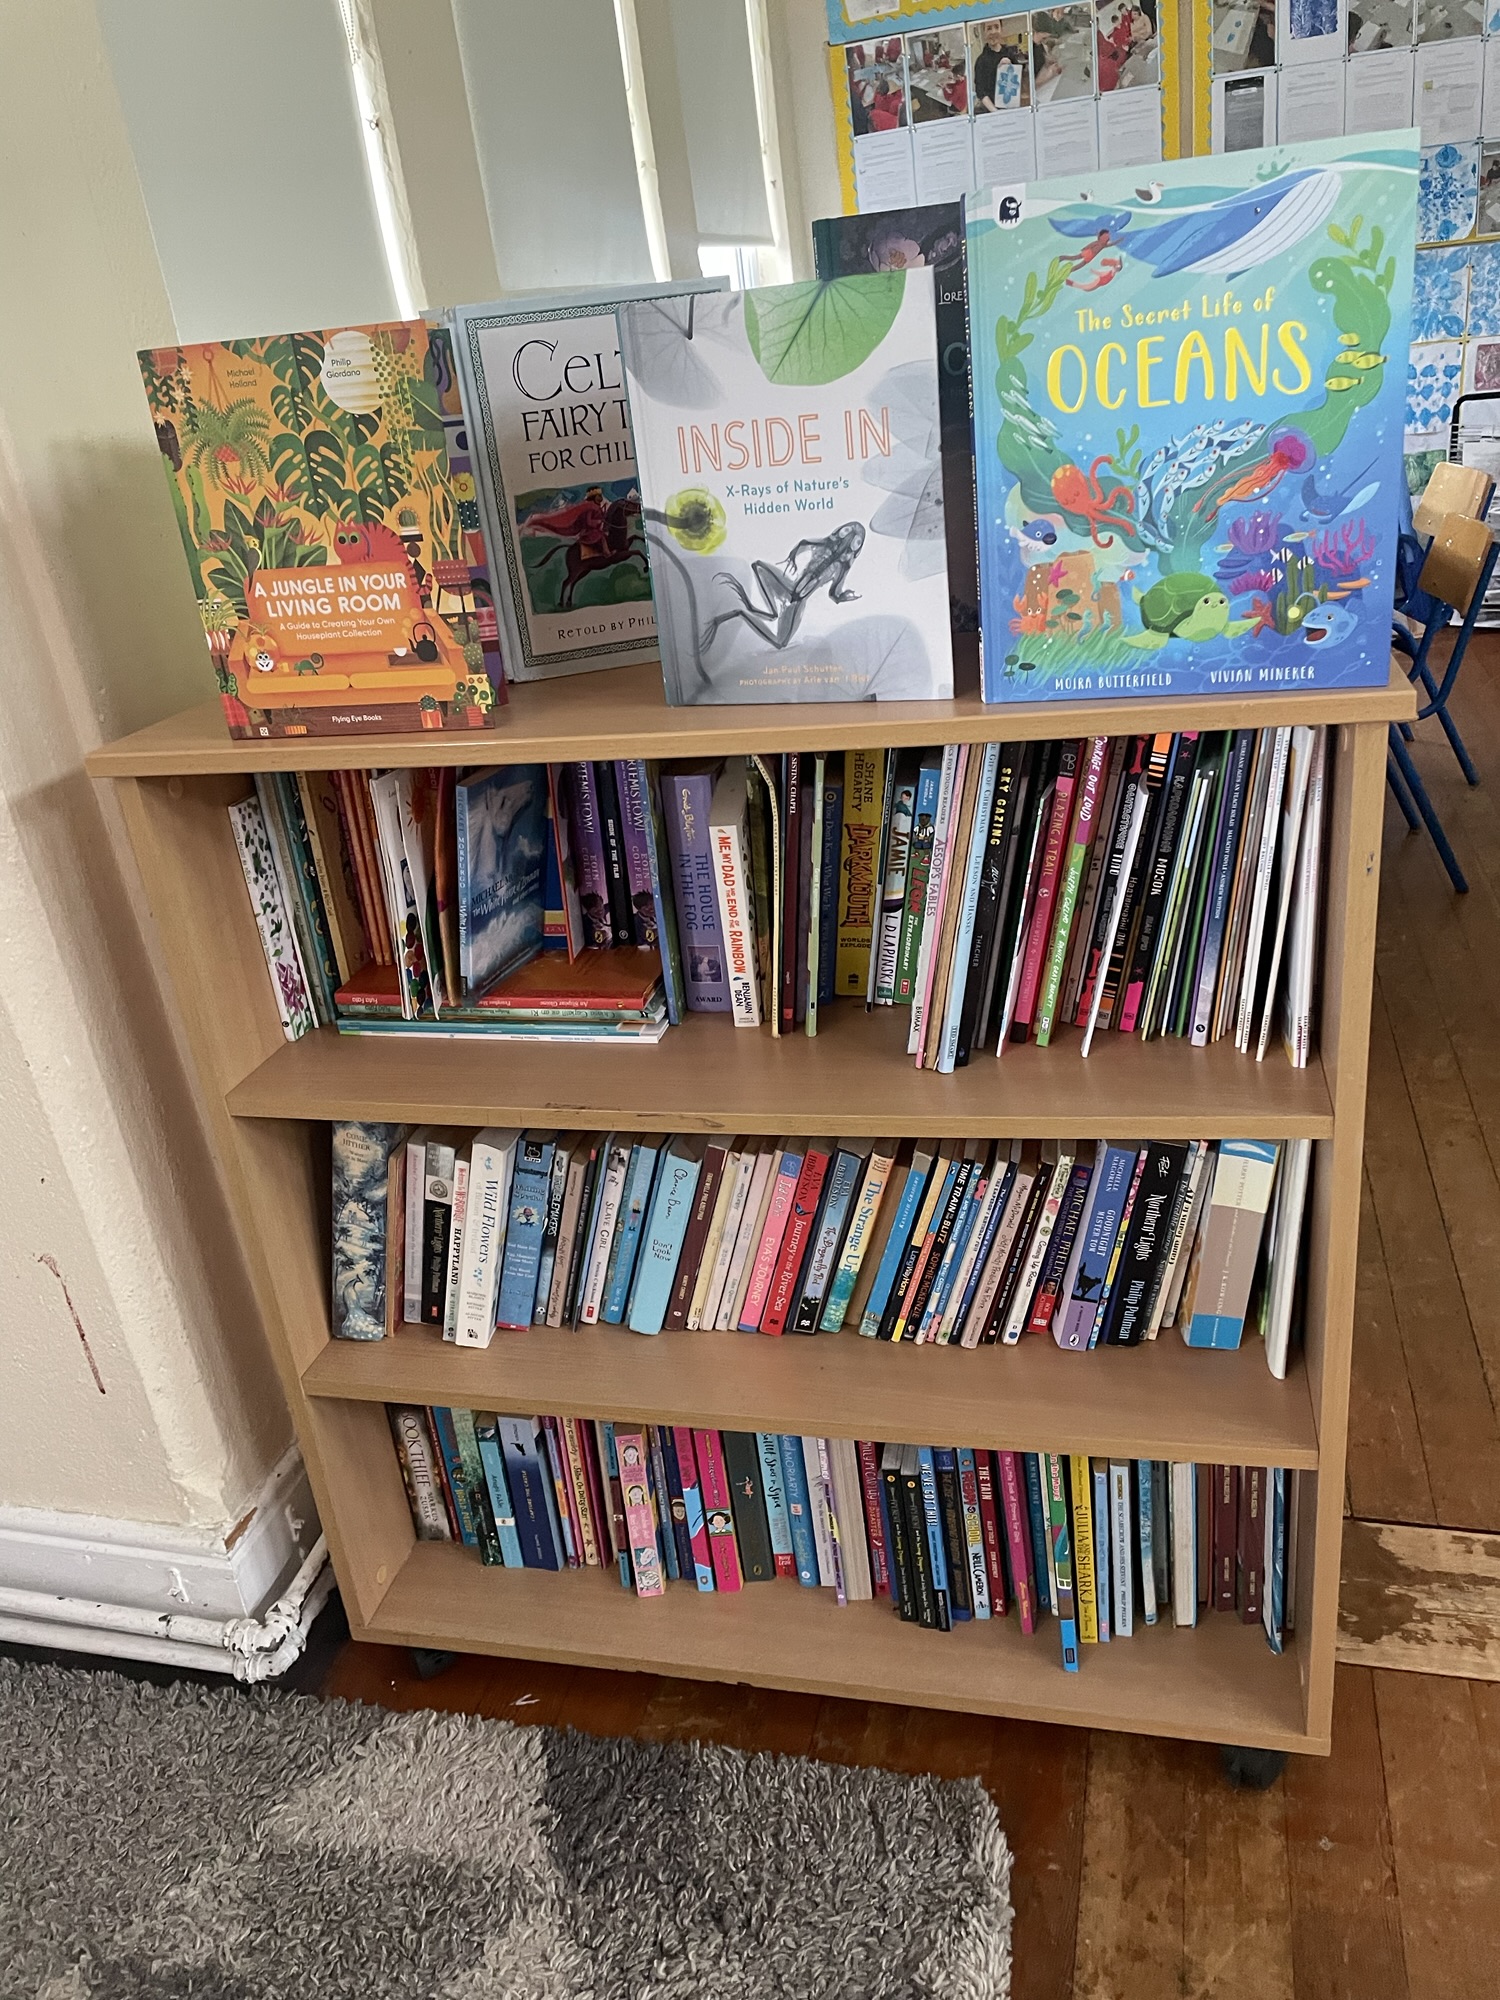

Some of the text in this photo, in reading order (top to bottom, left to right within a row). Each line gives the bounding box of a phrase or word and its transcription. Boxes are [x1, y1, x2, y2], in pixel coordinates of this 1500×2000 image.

[1074, 286, 1277, 333] The Secret Life of
[227, 368, 255, 378] Michael
[326, 368, 361, 379] Giordano
[331, 358, 351, 368] Philip
[1046, 321, 1312, 414] OCEANS
[229, 378, 257, 388] Holland
[520, 401, 603, 442] FAIRY
[529, 442, 634, 473] FOR CHIL
[677, 414, 822, 474] INSIDE
[844, 407, 892, 460] IN
[726, 477, 849, 498] X-Rays of Nature's
[743, 497, 834, 515] Hidden World
[254, 572, 407, 597] A JUNGLE IN YOUR
[266, 593, 401, 617] LIVING ROOM
[287, 622, 310, 630] Guide
[322, 619, 356, 629] Creating
[357, 618, 375, 626] Your
[297, 629, 382, 641] Houseplant Collection
[609, 621, 624, 631] BY
[628, 617, 657, 628] PHIL
[763, 665, 843, 674] Jan Schutten
[1055, 666, 1316, 691] MOIRA BUTTERFIELD VIVIAN MINEKER
[852, 752, 864, 811] HEGARTY
[864, 762, 875, 803] SHANE
[943, 772, 951, 794] YOUNG
[978, 754, 996, 833] GIFT CHRISTMAS
[1079, 775, 1098, 821] OUT LOUD
[631, 801, 645, 835] FOWL
[789, 787, 797, 815] CHAPEL
[939, 796, 948, 824] READERS
[990, 767, 1012, 846] SKY GAZING
[580, 802, 594, 835] FOWL
[581, 847, 592, 888] COLFER
[591, 855, 599, 880] EOIN
[632, 846, 642, 887] COLFER
[641, 853, 649, 879] EOIN
[722, 854, 732, 865] MY
[887, 827, 909, 877] JAMIE
[1042, 849, 1058, 877] TRAIL
[723, 865, 735, 887] DAD
[840, 823, 879, 928] DARKMOUTH
[927, 838, 946, 916] AESOP'S FABLES
[973, 855, 982, 884] LEESON
[1150, 858, 1168, 896] МОЗОК
[679, 854, 698, 930] IN THE FOG
[695, 853, 715, 930] THE HOUSE
[727, 898, 738, 918] END
[908, 869, 926, 913] LEON
[886, 923, 897, 932] D
[965, 905, 975, 935] HANSEN
[1054, 867, 1079, 963] JOSEPH DANIEL
[729, 930, 746, 974] RAINBOW
[879, 935, 897, 985] LAPINSKI
[902, 915, 913, 971] EXTRAORDINARY
[972, 935, 983, 967] THACHER
[734, 990, 744, 1007] DEAN
[742, 982, 753, 1014] BENJAMIN
[913, 1006, 923, 1033] BRIMAX
[798, 1155, 818, 1203] IBBOTSON
[811, 1172, 823, 1189] EVA
[829, 1163, 847, 1209] IBBOTSON
[841, 1181, 853, 1197] EVA
[957, 1164, 970, 1183] TIME
[1105, 1156, 1119, 1192] MAGORIAN
[1113, 1159, 1126, 1191] MICHELLE
[478, 1179, 499, 1264] Wild Flowers
[599, 1201, 615, 1250] SLAVE GIRL
[848, 1180, 883, 1251] The Strange
[1133, 1194, 1167, 1261] Northern Lights
[1170, 1194, 1185, 1227] Incredible
[927, 1185, 964, 1280] TRAIN BLITZ SOPHIE
[1051, 1187, 1086, 1278] MICHAEL PHELPS
[1089, 1211, 1105, 1252] MISTER TOM
[1096, 1209, 1116, 1256] GOODNIGHT
[1163, 1228, 1174, 1253] Journey
[451, 1228, 461, 1285] HAPPYLAND
[751, 1236, 774, 1307] EVA'S JOURNEY
[774, 1218, 806, 1311] Journey River Sea
[814, 1237, 833, 1272] Dragonfly
[1031, 1240, 1047, 1270] Coming Up
[1119, 1280, 1145, 1340] Philip Pullman
[411, 1450, 430, 1487] THIEF
[783, 1450, 798, 1498] MORIARTY
[978, 1466, 989, 1480] THE
[920, 1463, 937, 1526] WE'VE GOT THIS!
[1052, 1478, 1062, 1501] Move!
[420, 1496, 431, 1520] ZUSAK
[427, 1492, 438, 1522] MARKUS
[868, 1507, 877, 1537] DISASTER
[962, 1471, 981, 1547] FREDDY SCHOOL
[1077, 1511, 1092, 1597] JULIA SHARK
[971, 1552, 985, 1596] NEILL CAMERON
